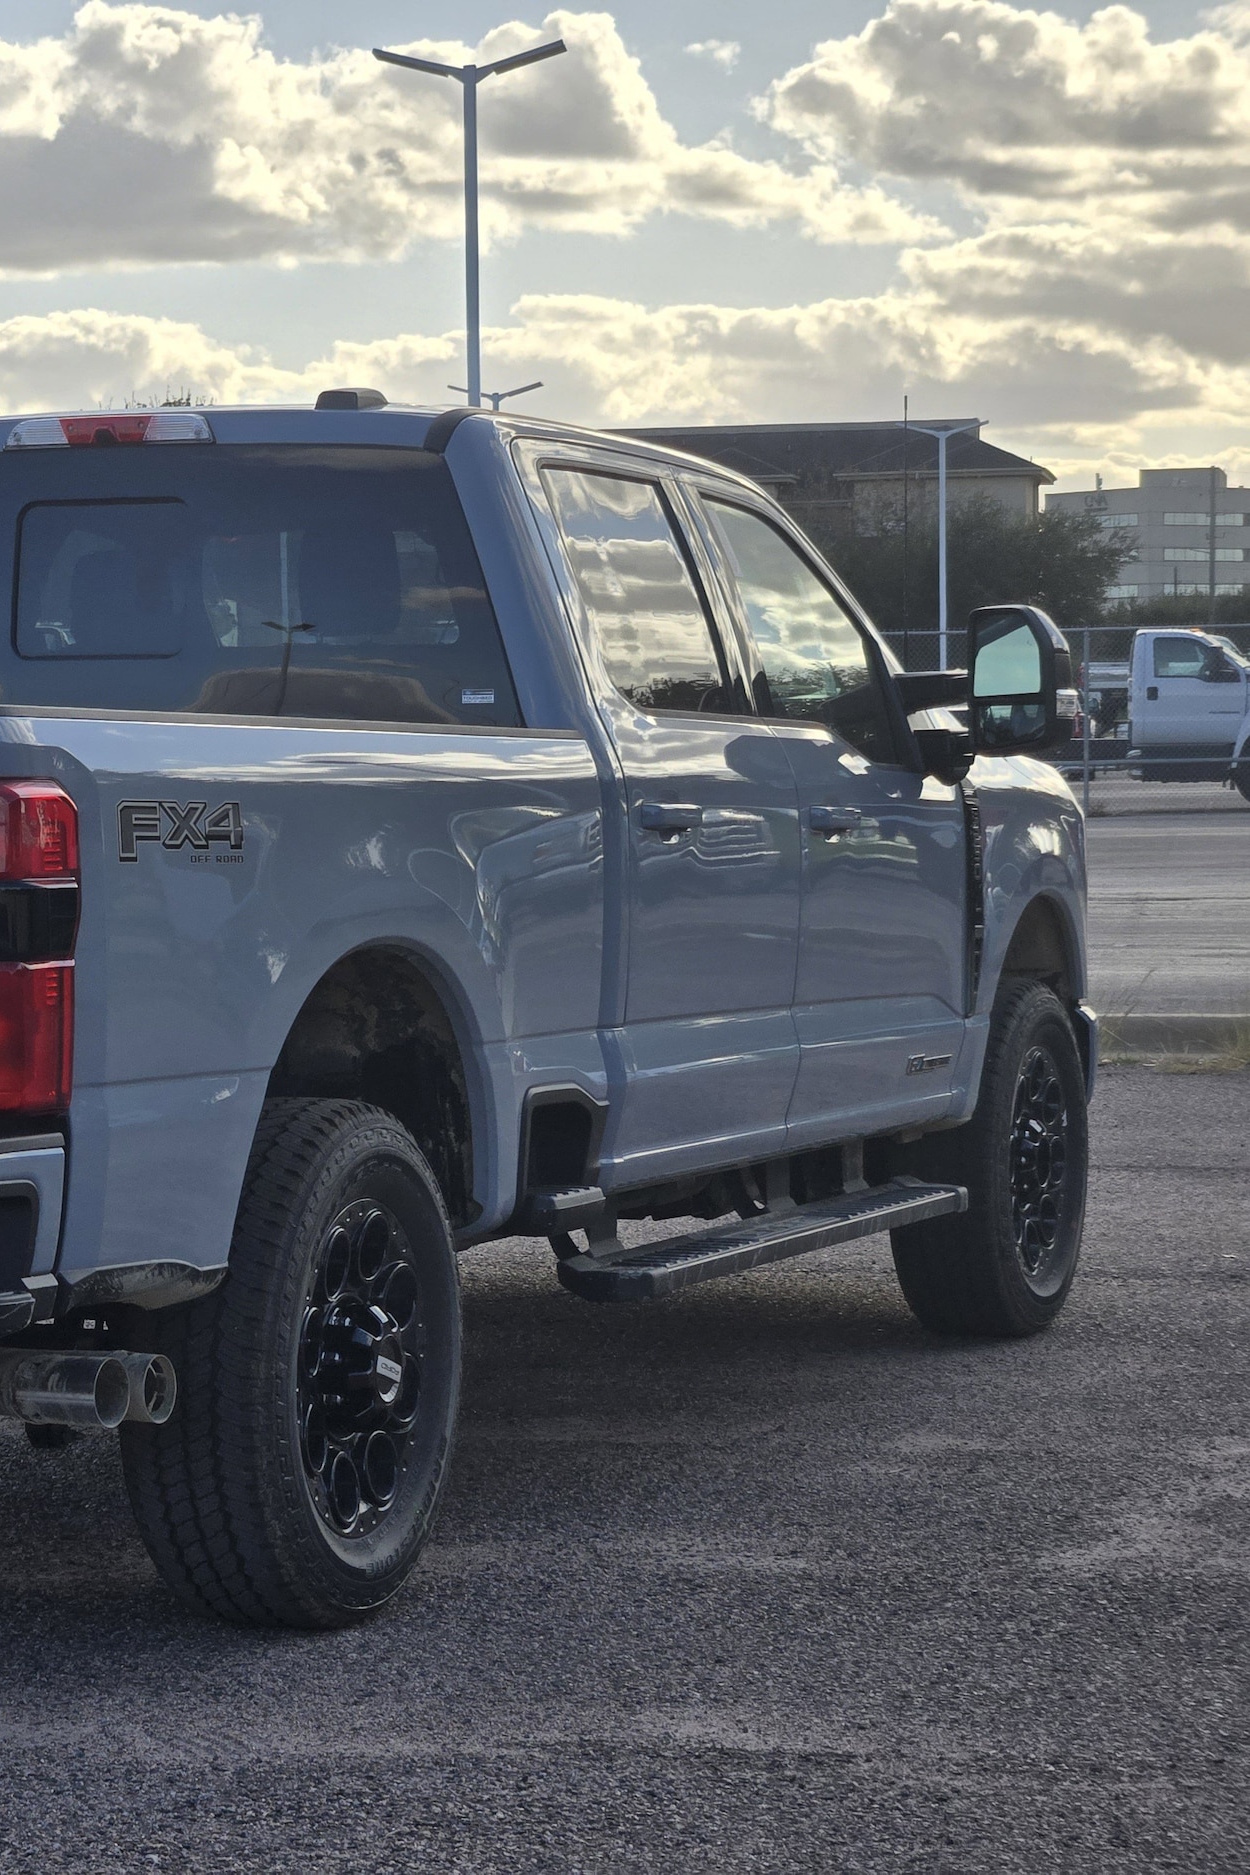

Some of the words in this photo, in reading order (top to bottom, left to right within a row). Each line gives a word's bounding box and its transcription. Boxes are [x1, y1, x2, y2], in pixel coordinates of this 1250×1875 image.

[117, 799, 244, 864] FX4
[190, 855, 211, 863] OFF
[215, 855, 244, 863] ROAD
